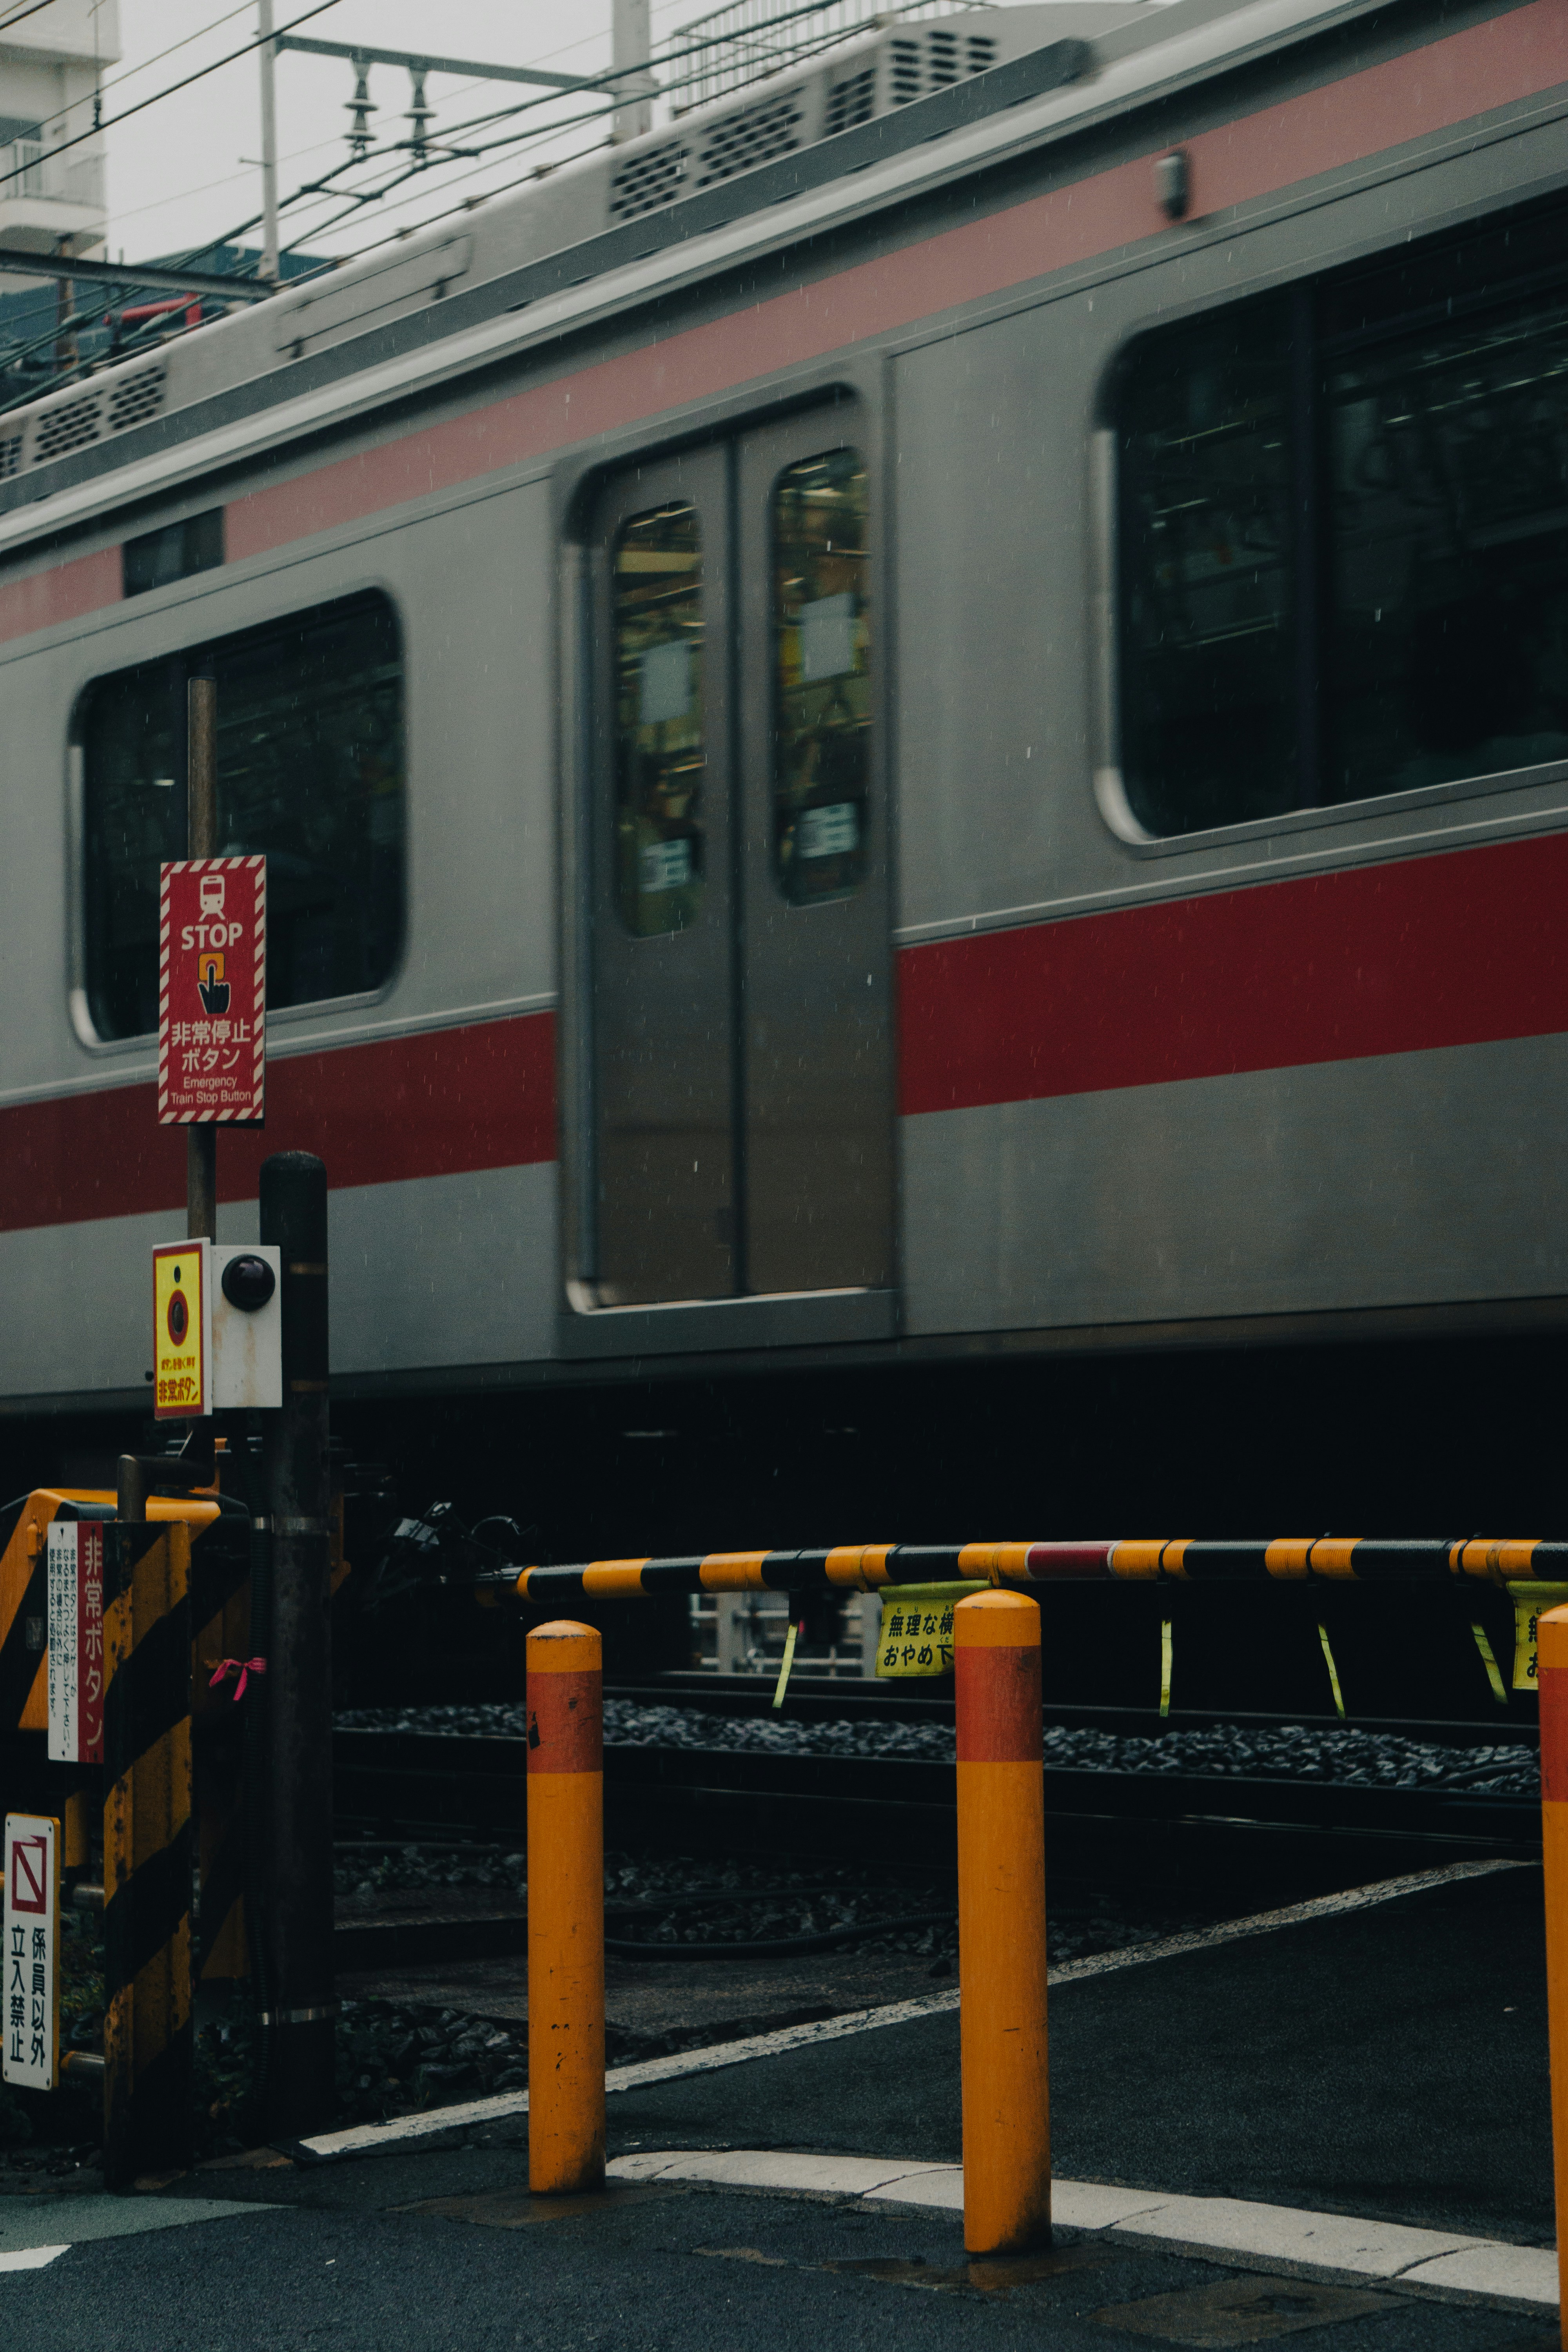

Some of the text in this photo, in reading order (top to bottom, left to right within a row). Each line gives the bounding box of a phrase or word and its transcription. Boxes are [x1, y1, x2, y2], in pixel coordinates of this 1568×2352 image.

[181, 922, 243, 950] STOP
[172, 1018, 251, 1047] 非常停止
[182, 1047, 240, 1073] ボタン
[171, 1090, 251, 1105] Train Stop Button
[183, 1076, 237, 1091] Emergency
[158, 1376, 198, 1403] 非常ボタン
[84, 1535, 103, 1746] 非常ボタン
[10, 1924, 25, 2063] 立入禁止
[31, 1927, 46, 2068] 係員以外
